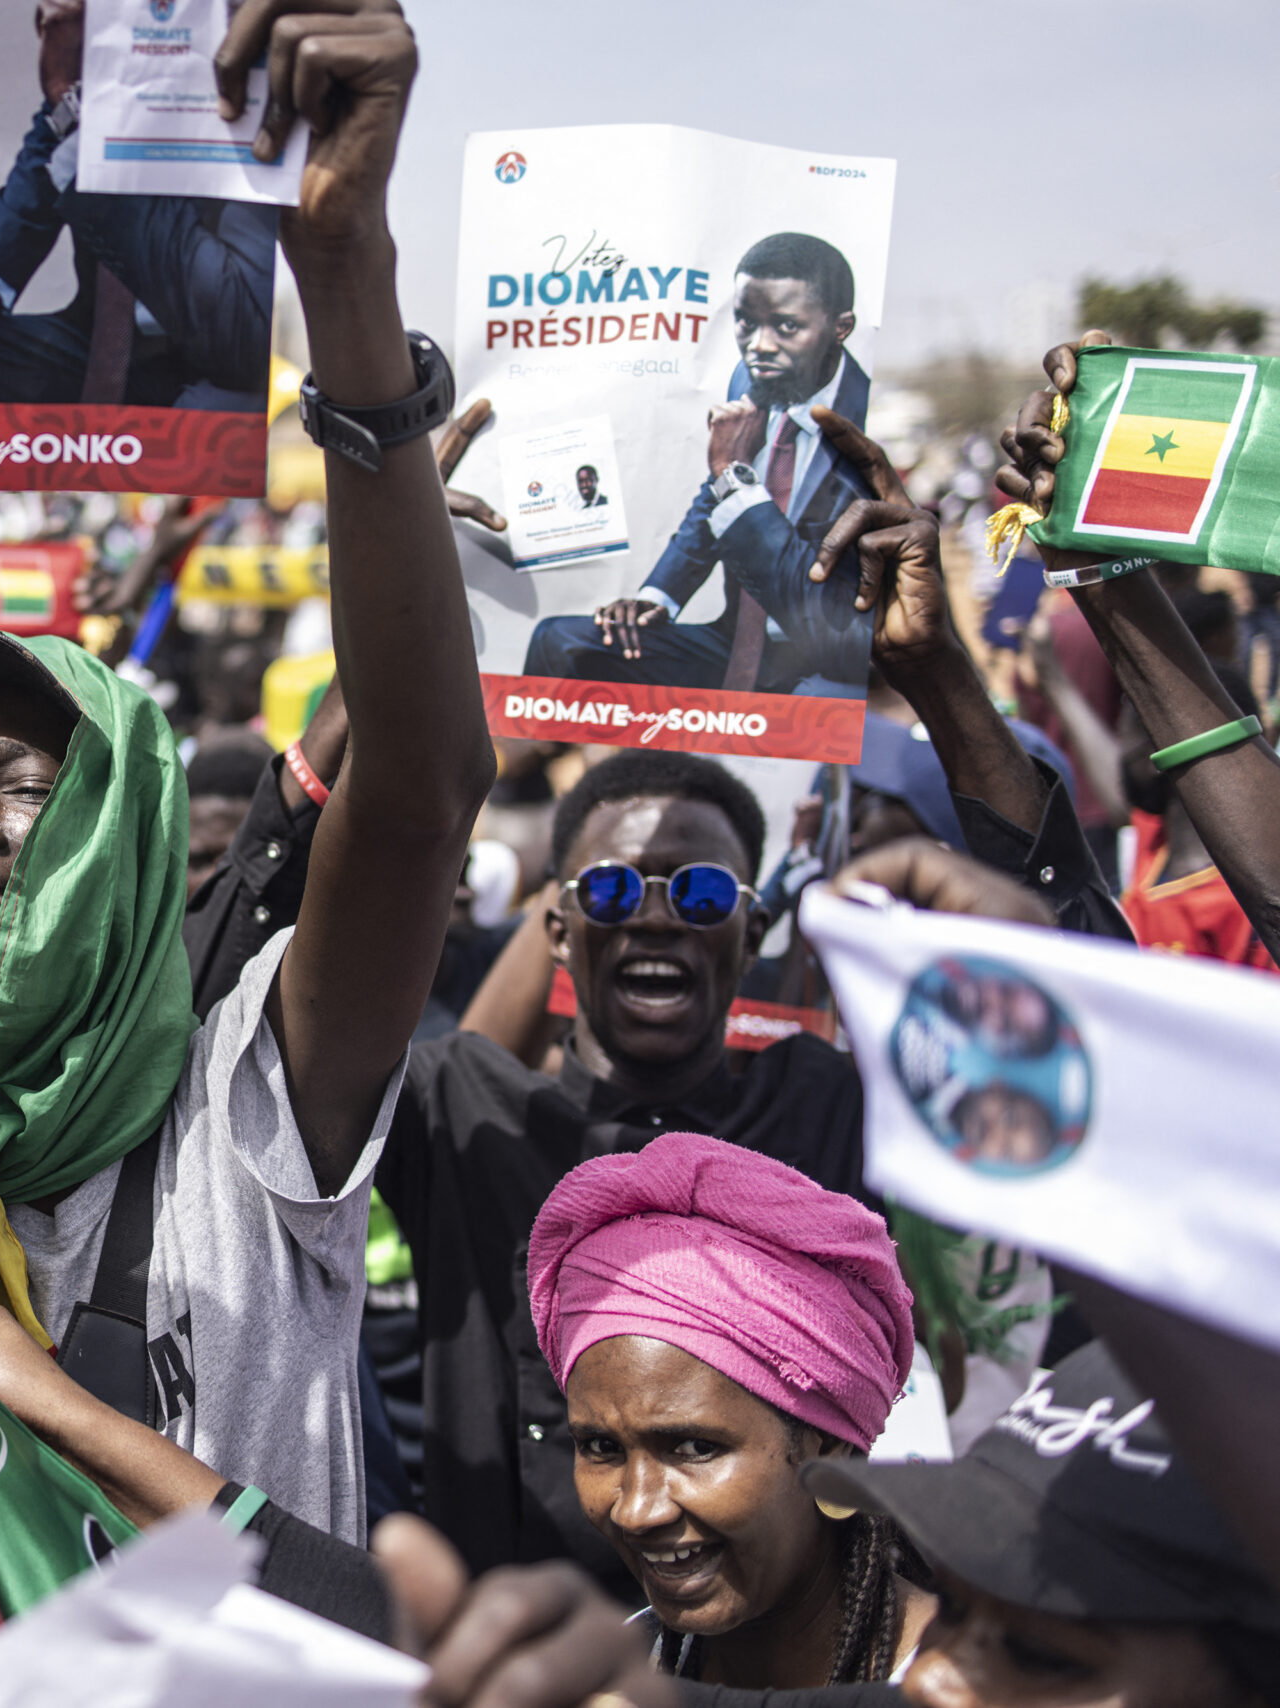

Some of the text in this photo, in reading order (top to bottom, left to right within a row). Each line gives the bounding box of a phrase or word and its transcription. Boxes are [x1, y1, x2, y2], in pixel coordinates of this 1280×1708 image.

[542, 229, 628, 278] Votez
[488, 266, 710, 308] DIOMAYE
[486, 309, 709, 350] PRÉSIDENT
[9, 433, 143, 465] SONKO
[505, 695, 629, 726] DIOMAYE
[666, 708, 768, 736] SONKO
